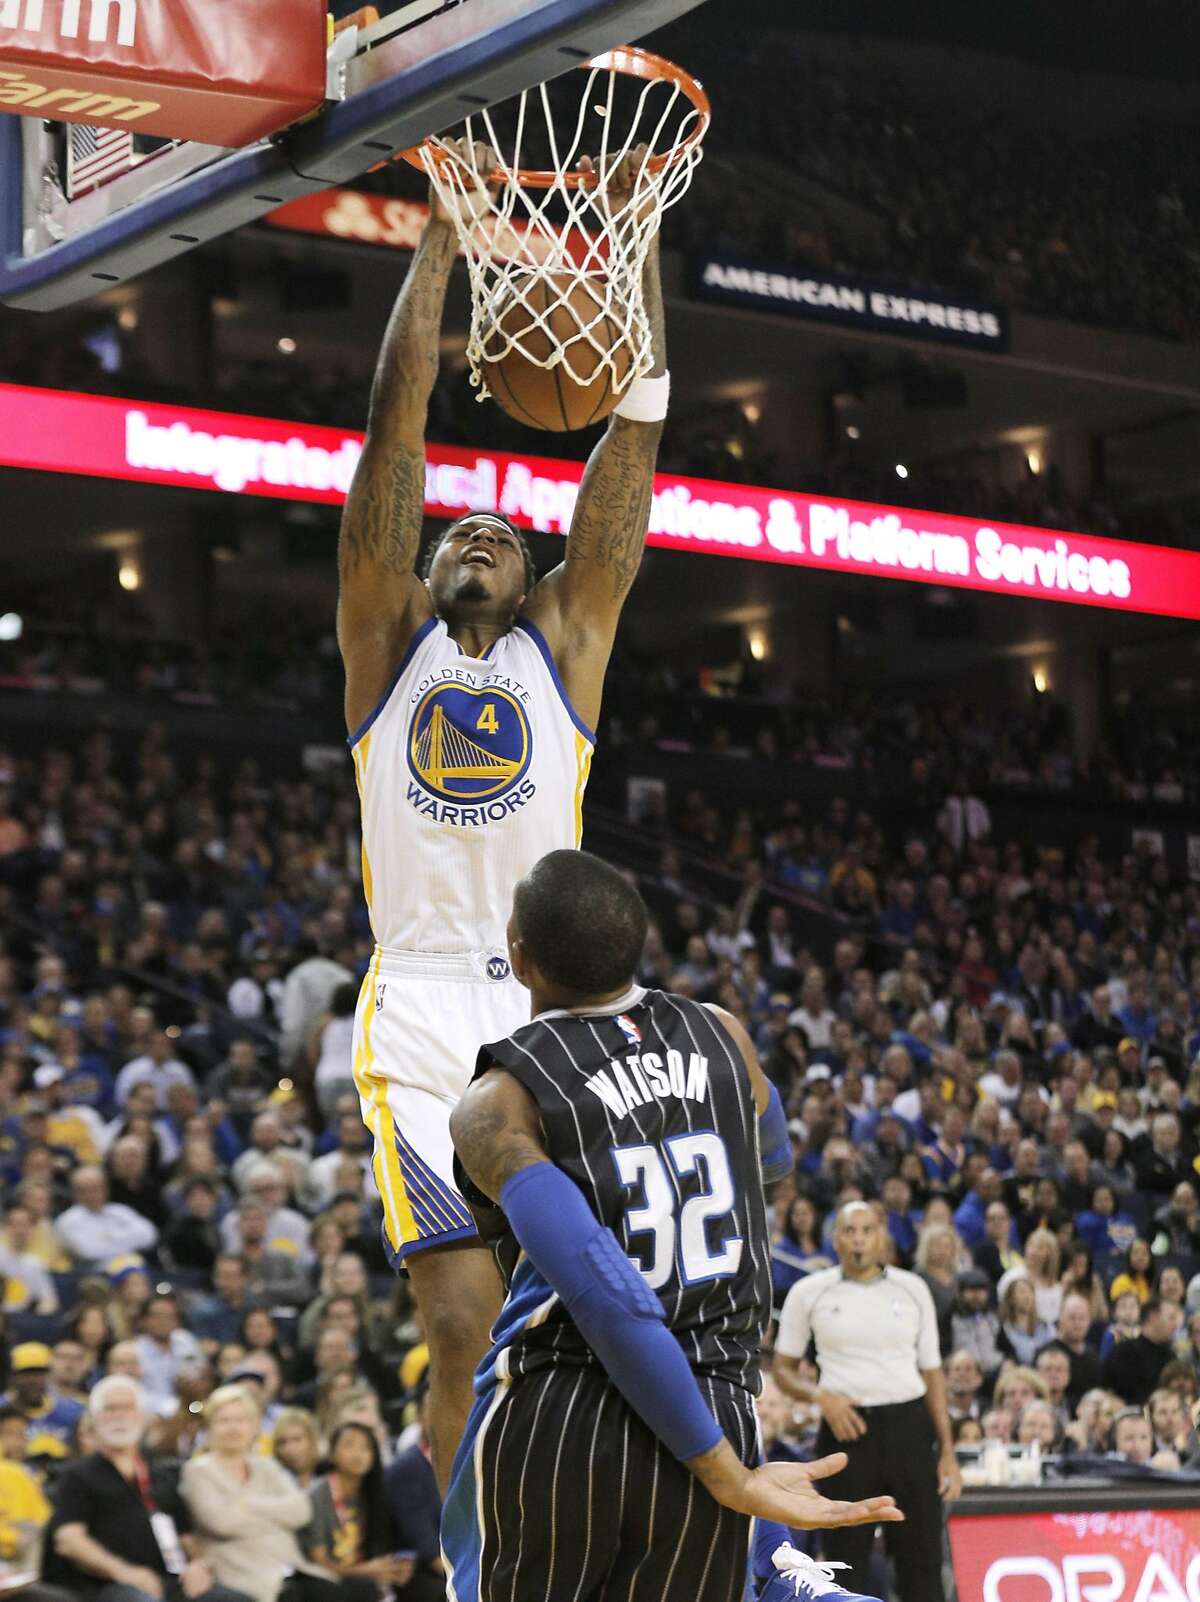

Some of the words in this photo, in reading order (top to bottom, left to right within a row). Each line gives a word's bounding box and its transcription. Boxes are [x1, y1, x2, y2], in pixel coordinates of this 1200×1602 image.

[703, 262, 866, 313] AMERICAN
[869, 292, 1000, 338] EXPRESS
[125, 410, 363, 493] Integrated
[766, 498, 805, 554] &
[808, 503, 969, 576] Platform
[975, 527, 1132, 599] Services
[411, 668, 477, 704] GOLDEN
[481, 674, 532, 704] STATE
[476, 703, 500, 735] 4
[406, 779, 537, 826] WARRIORS
[584, 1049, 709, 1120] WATSON
[609, 1128, 744, 1291] 32
[983, 1552, 1200, 1602] ORA
